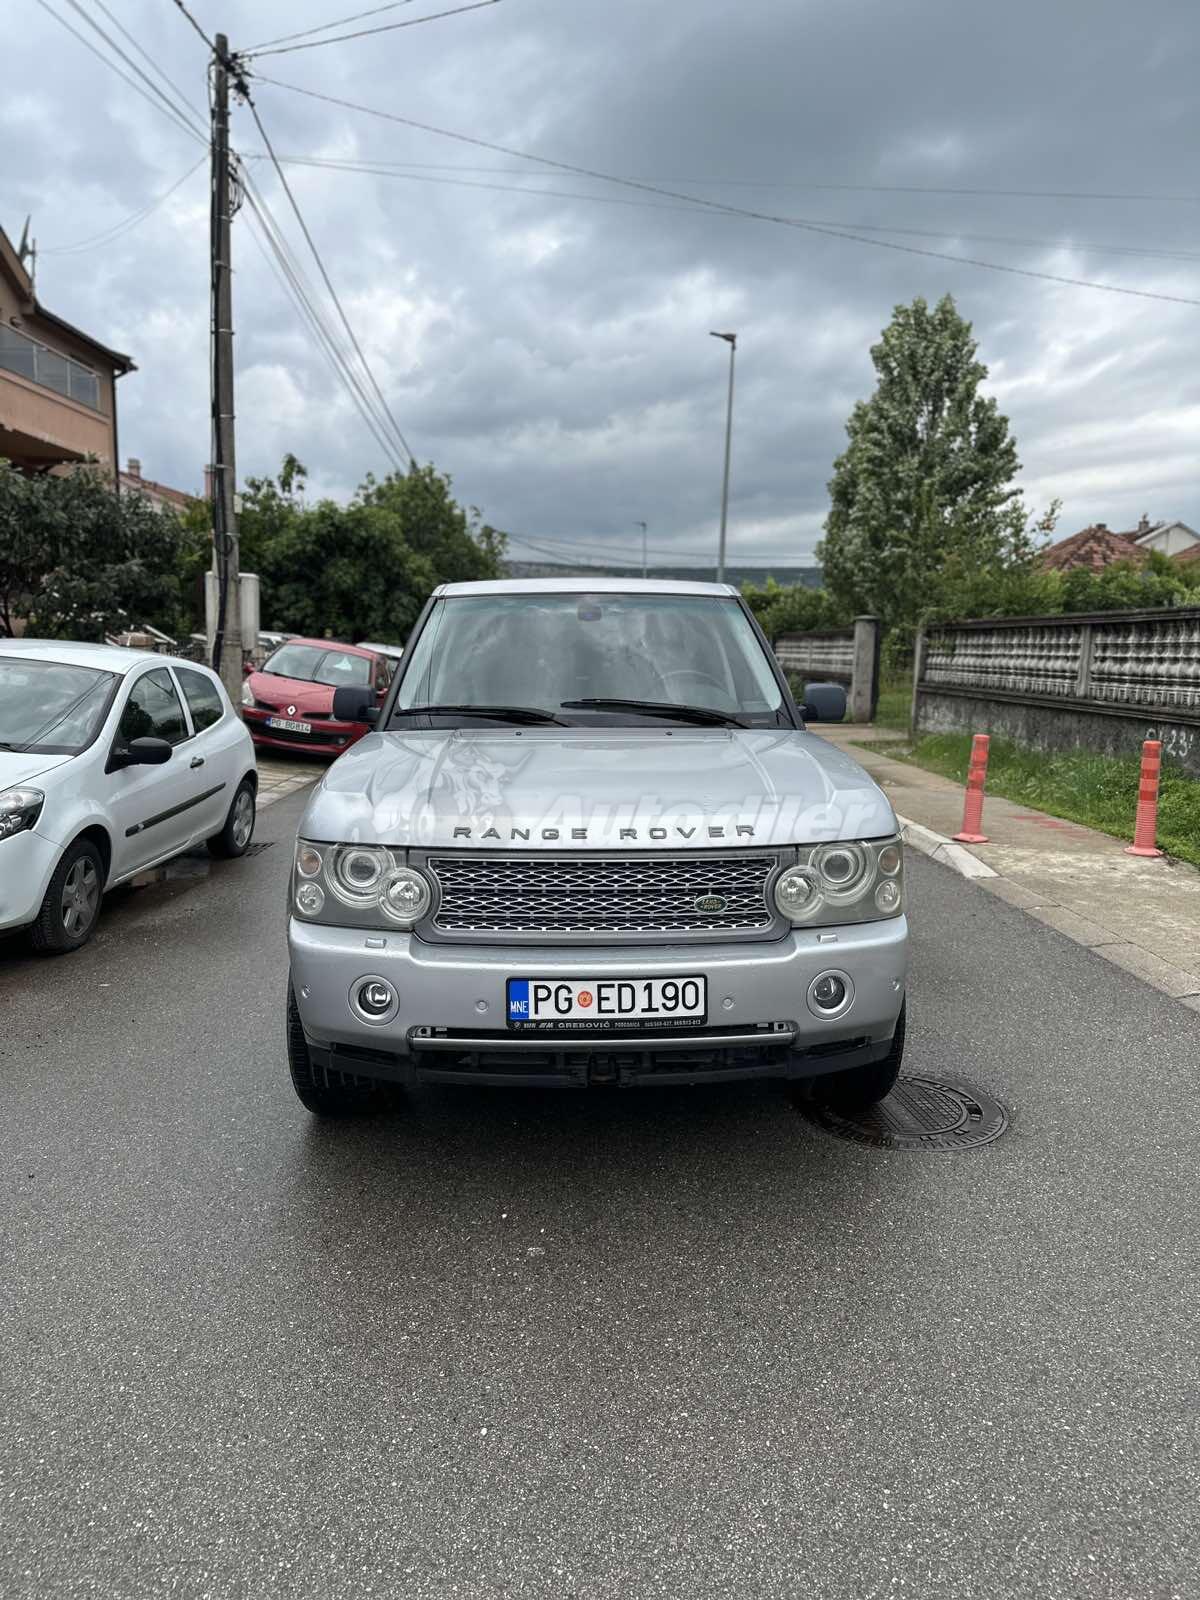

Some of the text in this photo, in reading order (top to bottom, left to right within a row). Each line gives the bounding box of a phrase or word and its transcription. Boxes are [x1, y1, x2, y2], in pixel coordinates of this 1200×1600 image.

[453, 825, 755, 840] RANGE ROVER
[533, 980, 700, 1015] PG ED190
[510, 1000, 529, 1014] MNE
